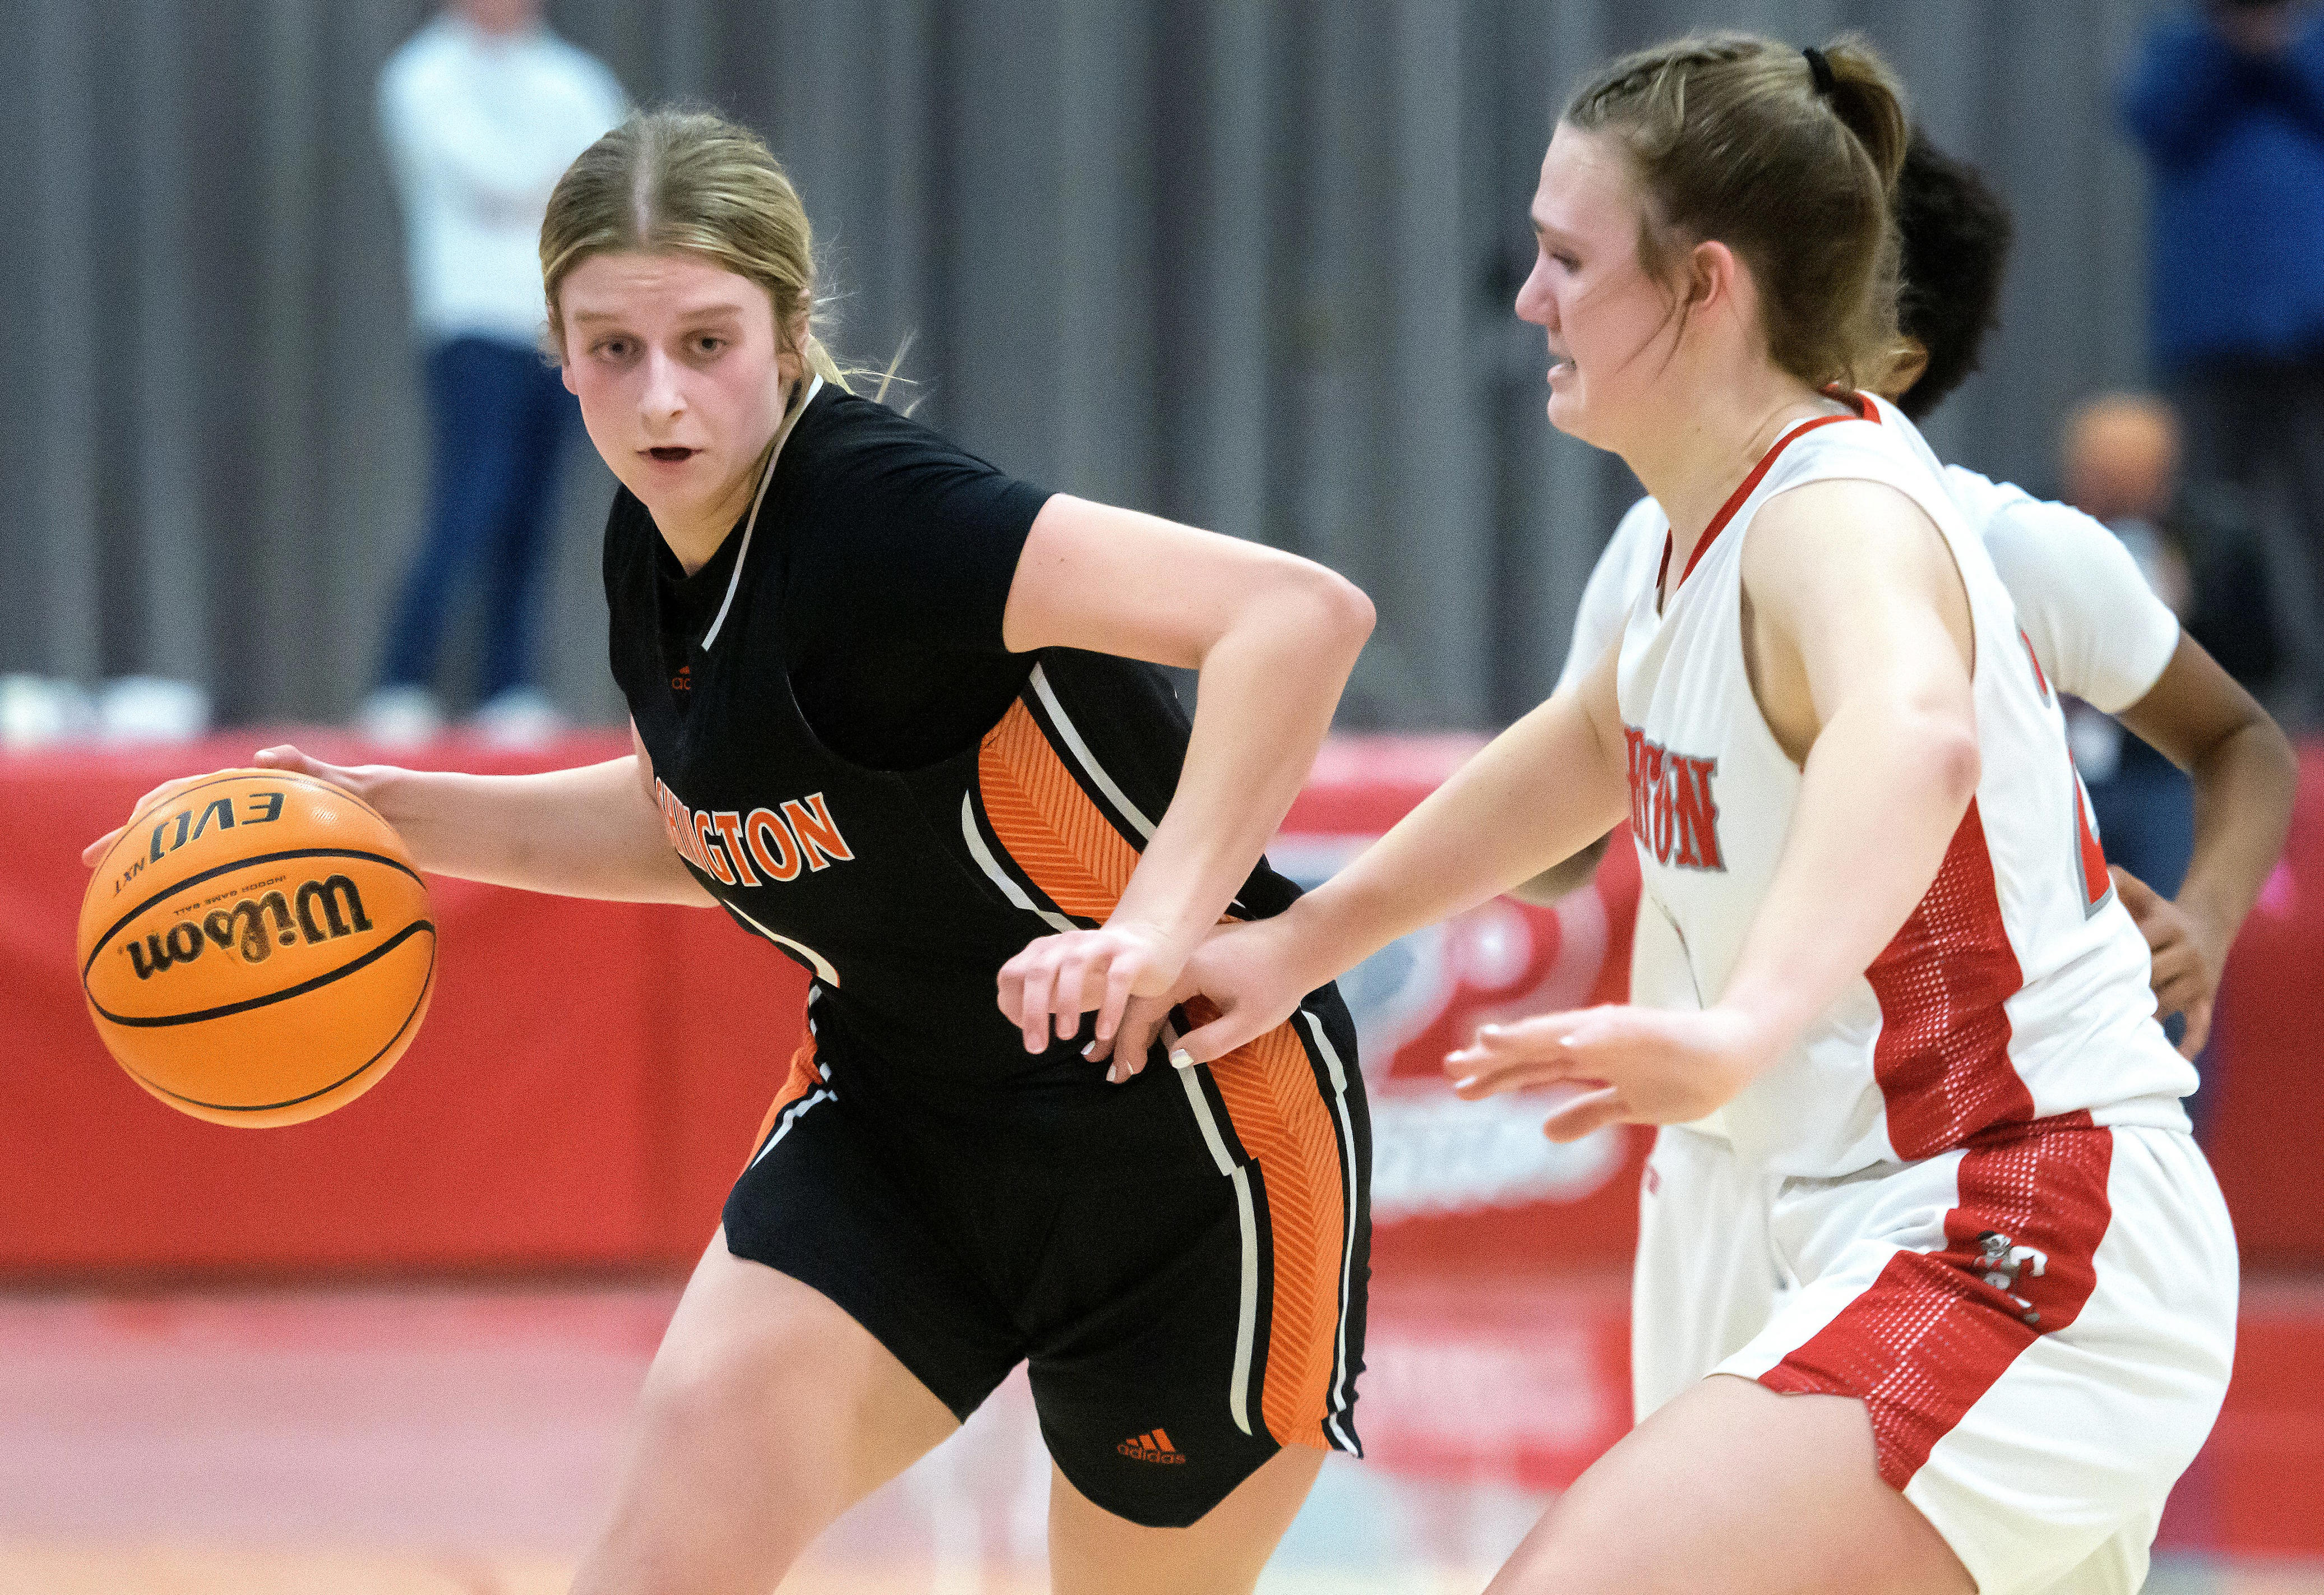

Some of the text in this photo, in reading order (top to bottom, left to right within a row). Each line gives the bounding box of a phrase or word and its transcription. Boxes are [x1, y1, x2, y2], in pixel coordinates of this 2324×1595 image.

[114, 792, 285, 894] EVO NXT
[125, 873, 374, 981] Wilson
[174, 875, 286, 916] INDOOR GAME BALL
[1117, 1444, 1186, 1464] adidas
